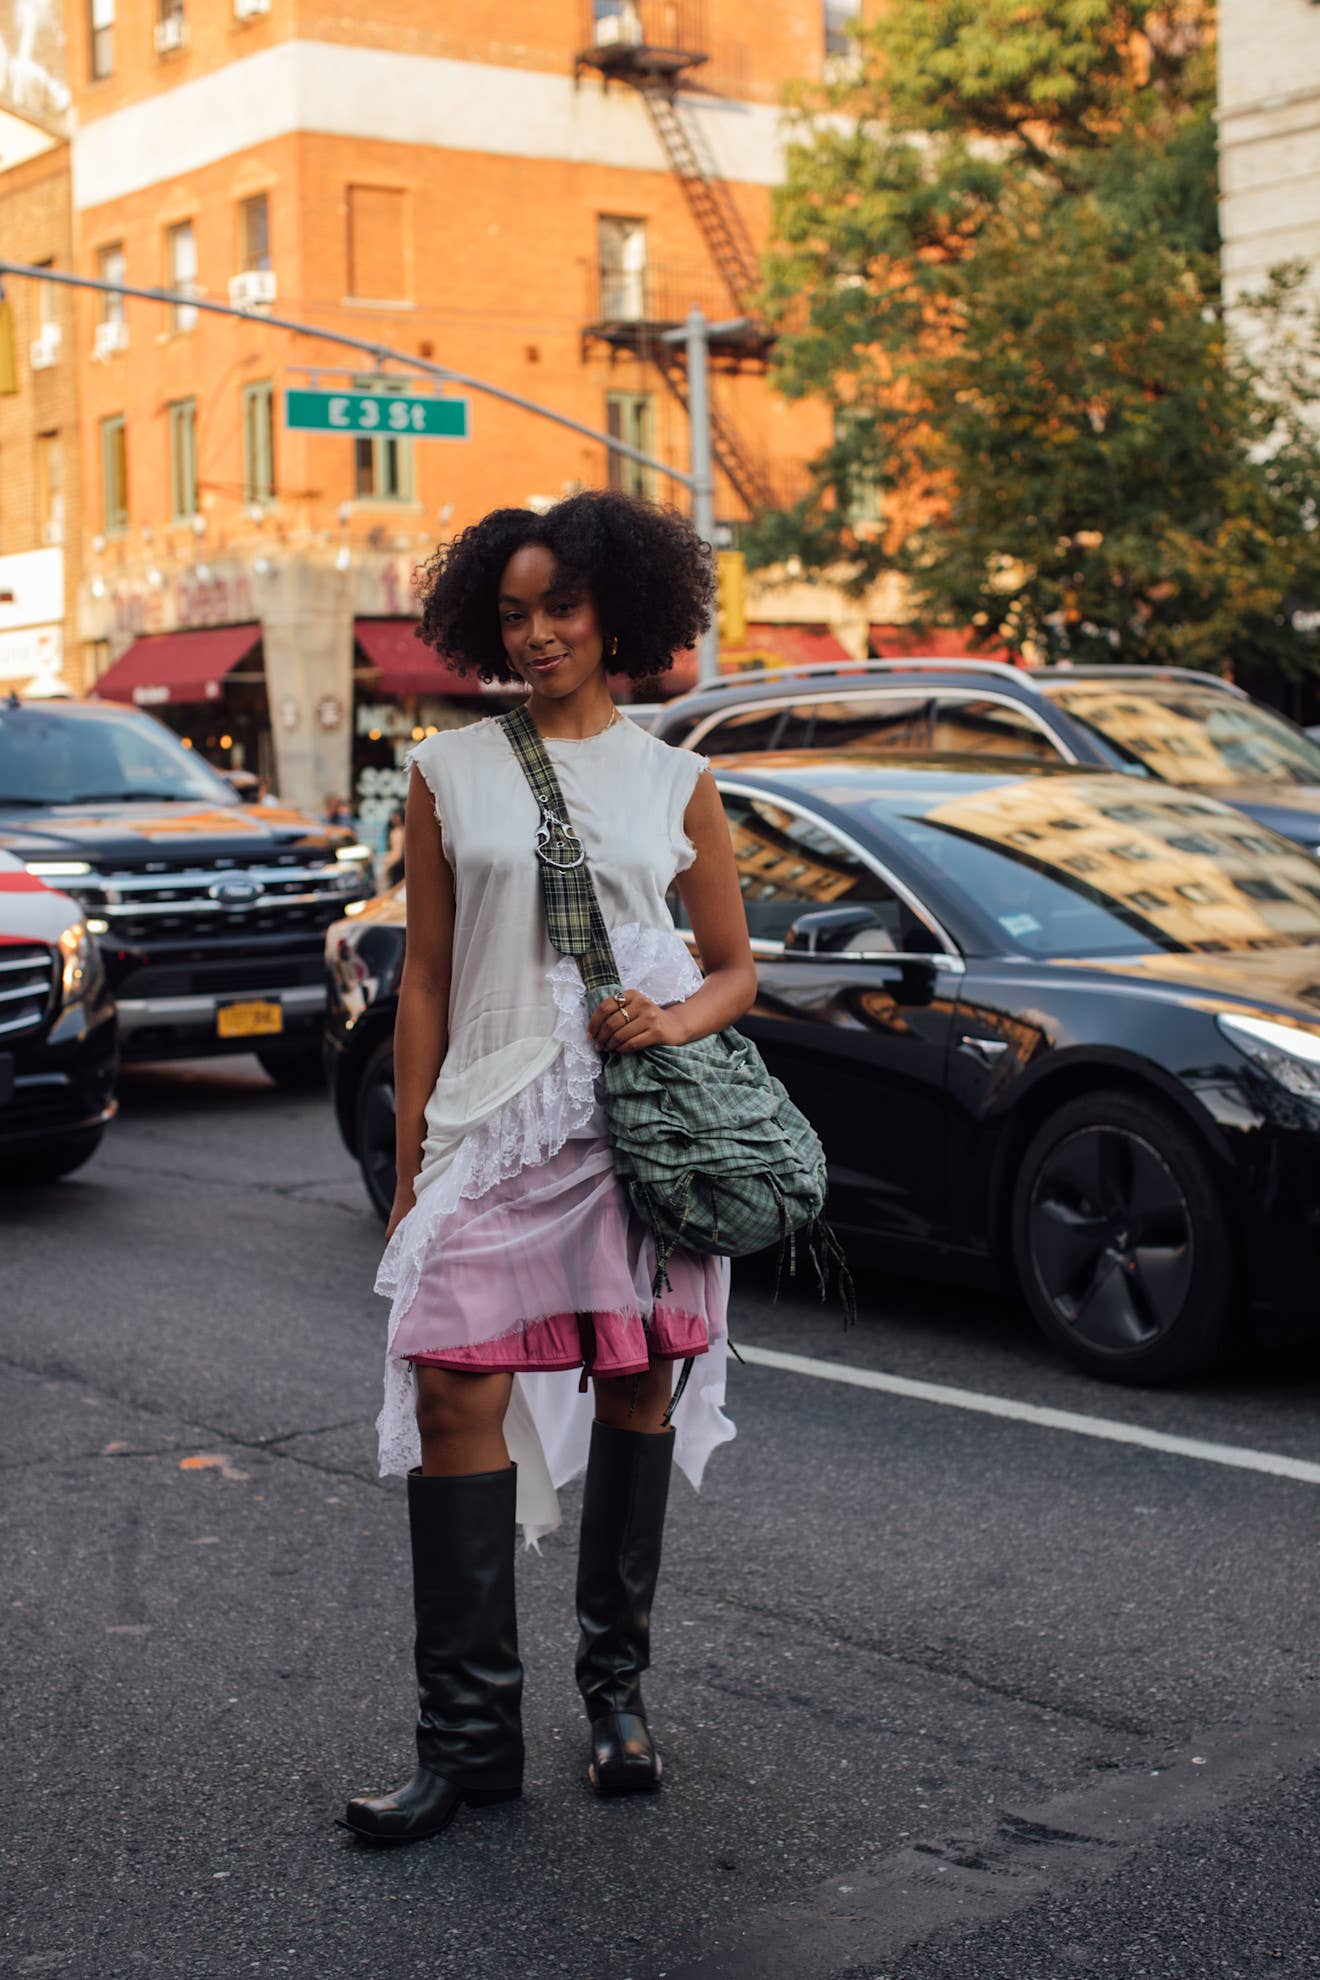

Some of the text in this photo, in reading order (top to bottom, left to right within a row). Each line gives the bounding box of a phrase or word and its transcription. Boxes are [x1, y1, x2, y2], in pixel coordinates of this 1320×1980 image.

[328, 397, 426, 431] E 3 St
